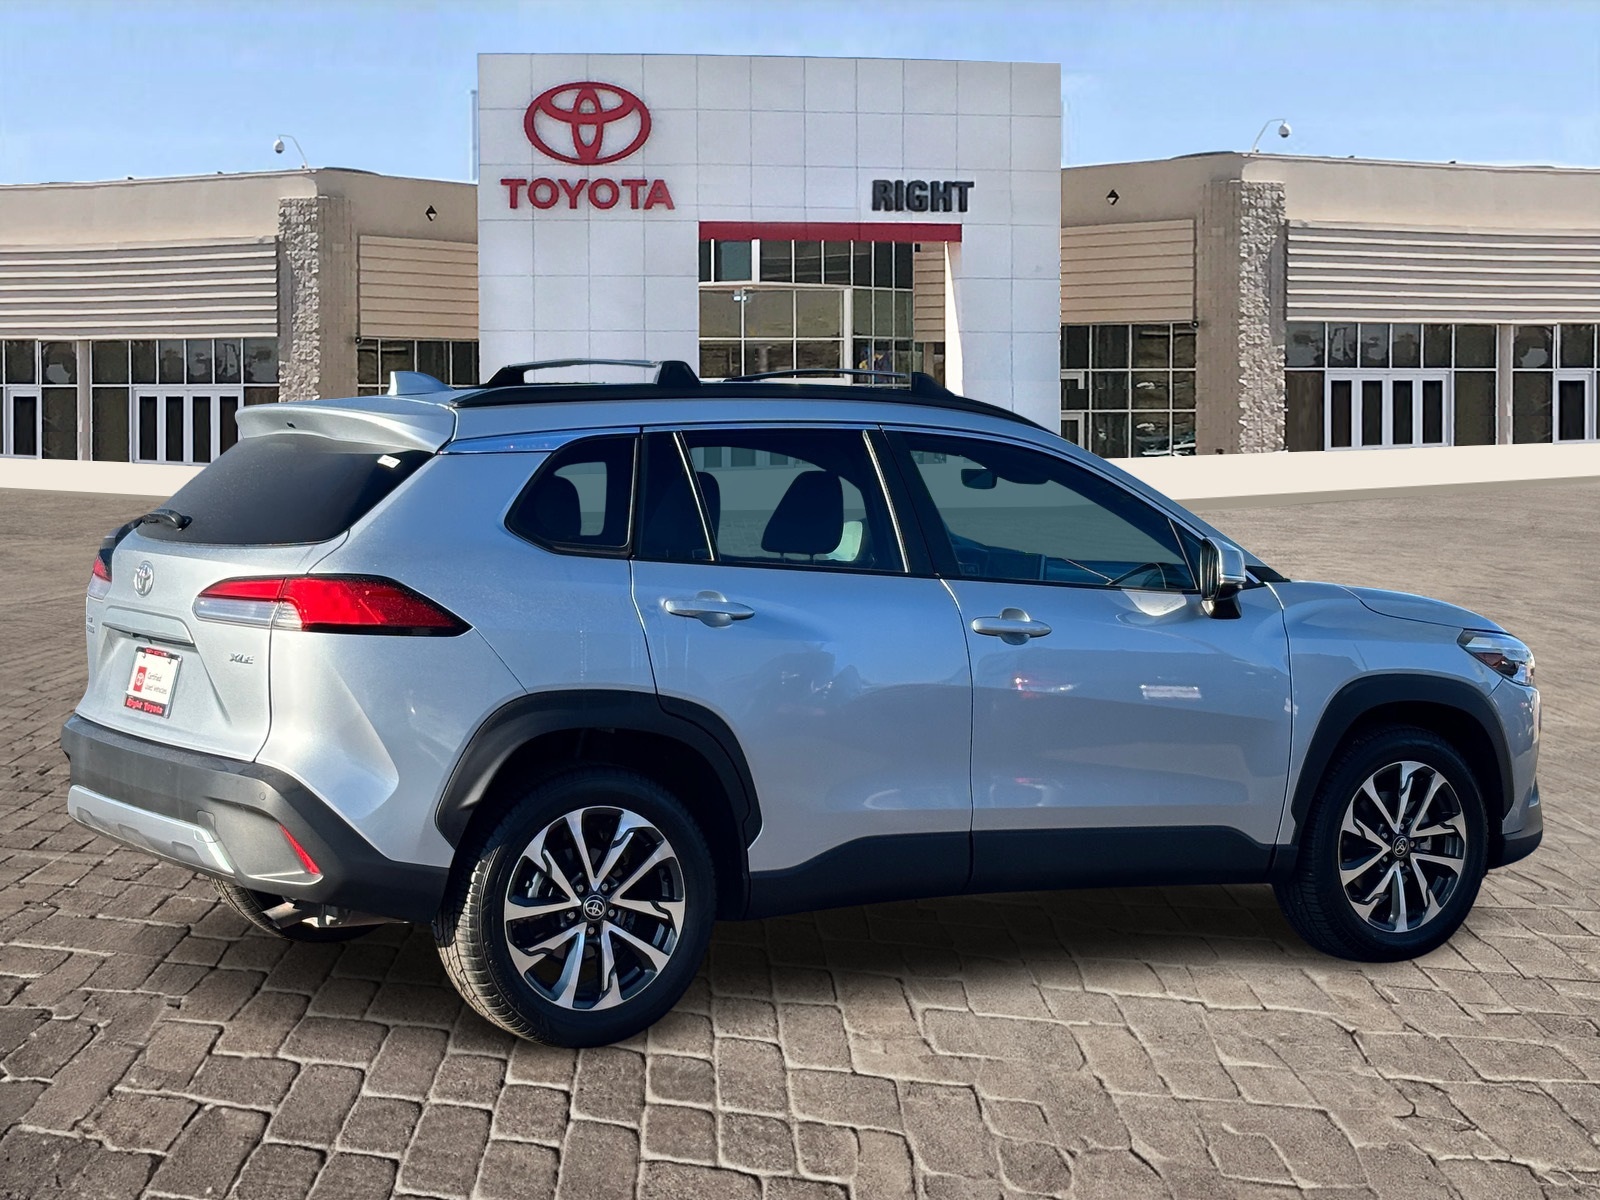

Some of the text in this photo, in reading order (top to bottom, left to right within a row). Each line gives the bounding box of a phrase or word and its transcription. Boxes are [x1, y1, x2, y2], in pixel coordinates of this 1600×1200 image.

[501, 178, 675, 210] TOYOTA
[872, 179, 974, 212] RIGHT
[229, 653, 255, 665] XLE
[143, 702, 163, 714] Toyota
